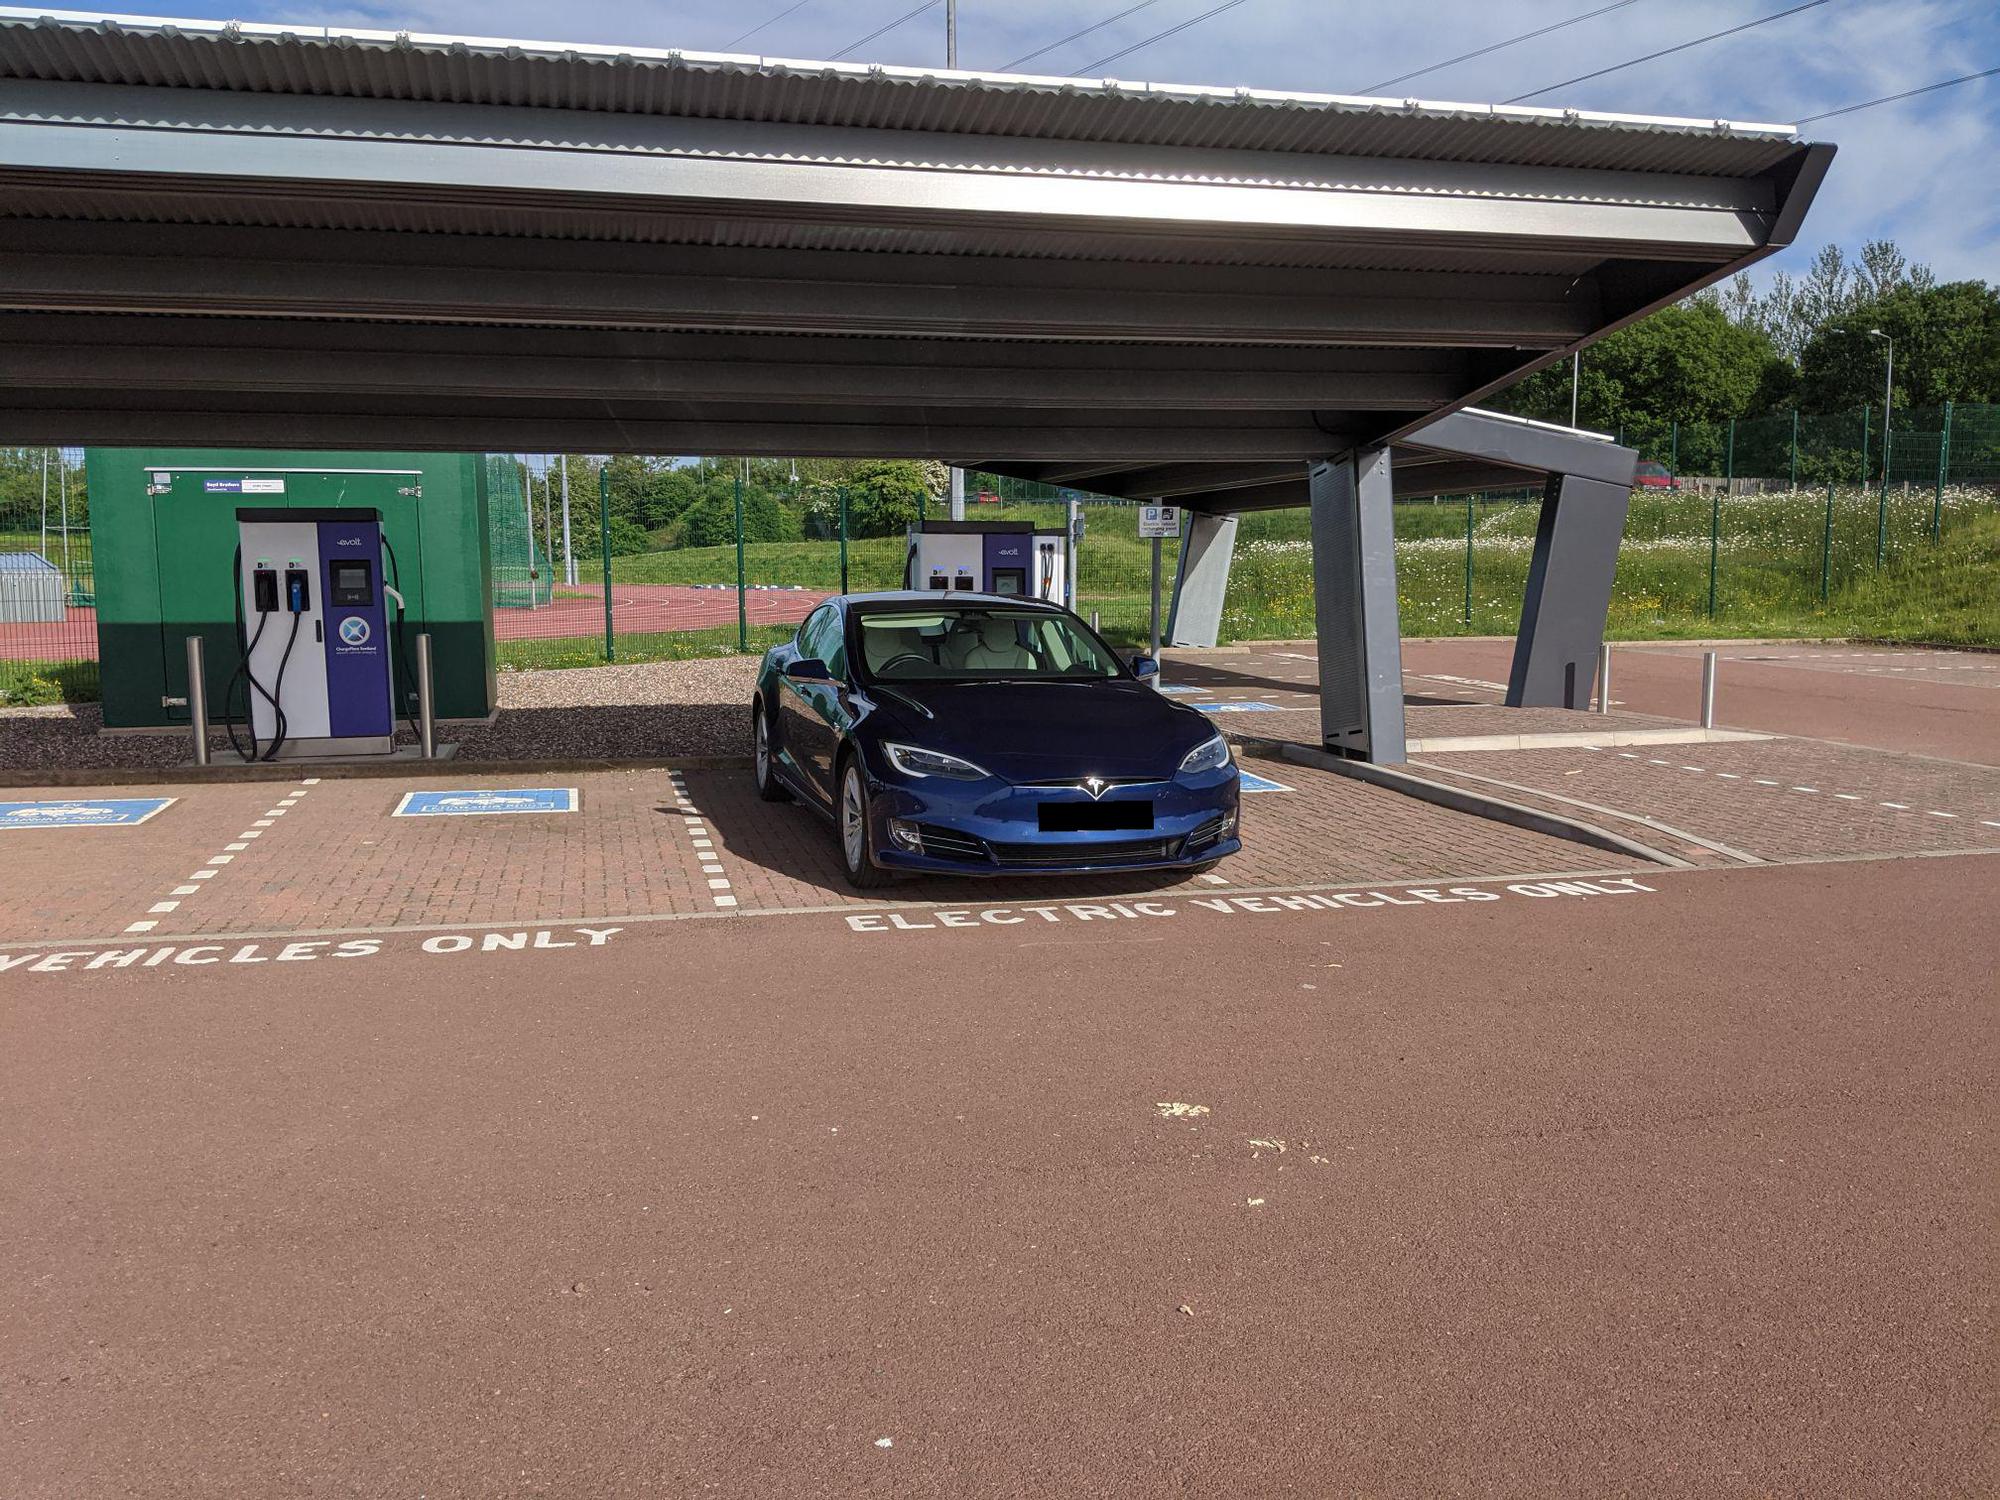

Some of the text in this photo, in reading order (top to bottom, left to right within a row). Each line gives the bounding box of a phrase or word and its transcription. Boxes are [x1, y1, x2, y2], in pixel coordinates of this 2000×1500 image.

[845, 878, 1659, 932] ELECTRIC VEHICLES ONLY
[421, 927, 624, 953] ONLY
